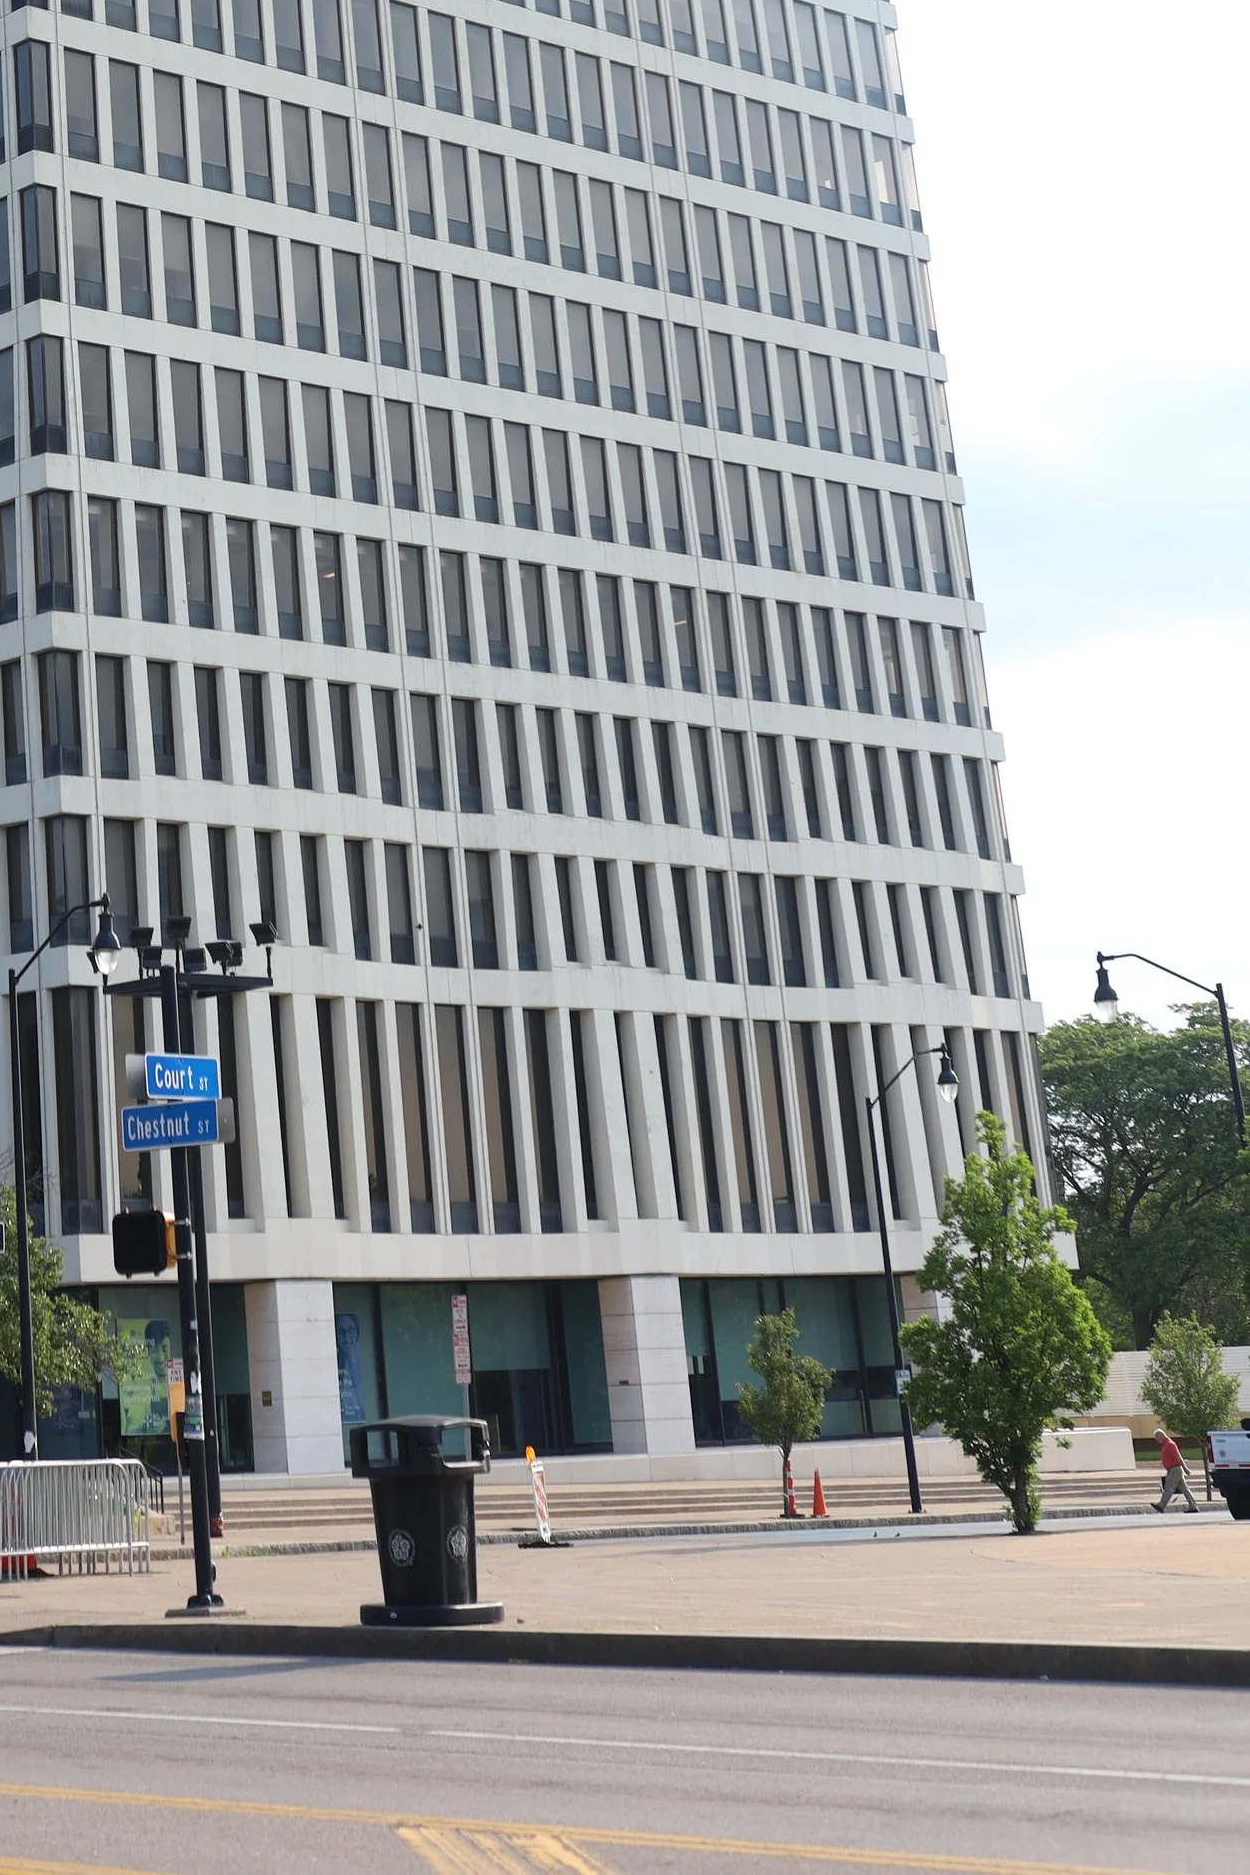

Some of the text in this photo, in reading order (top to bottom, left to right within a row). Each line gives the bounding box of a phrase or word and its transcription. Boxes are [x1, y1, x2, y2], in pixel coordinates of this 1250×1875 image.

[155, 1063, 208, 1091] Court ST
[127, 1110, 210, 1141] Chestnut ST
